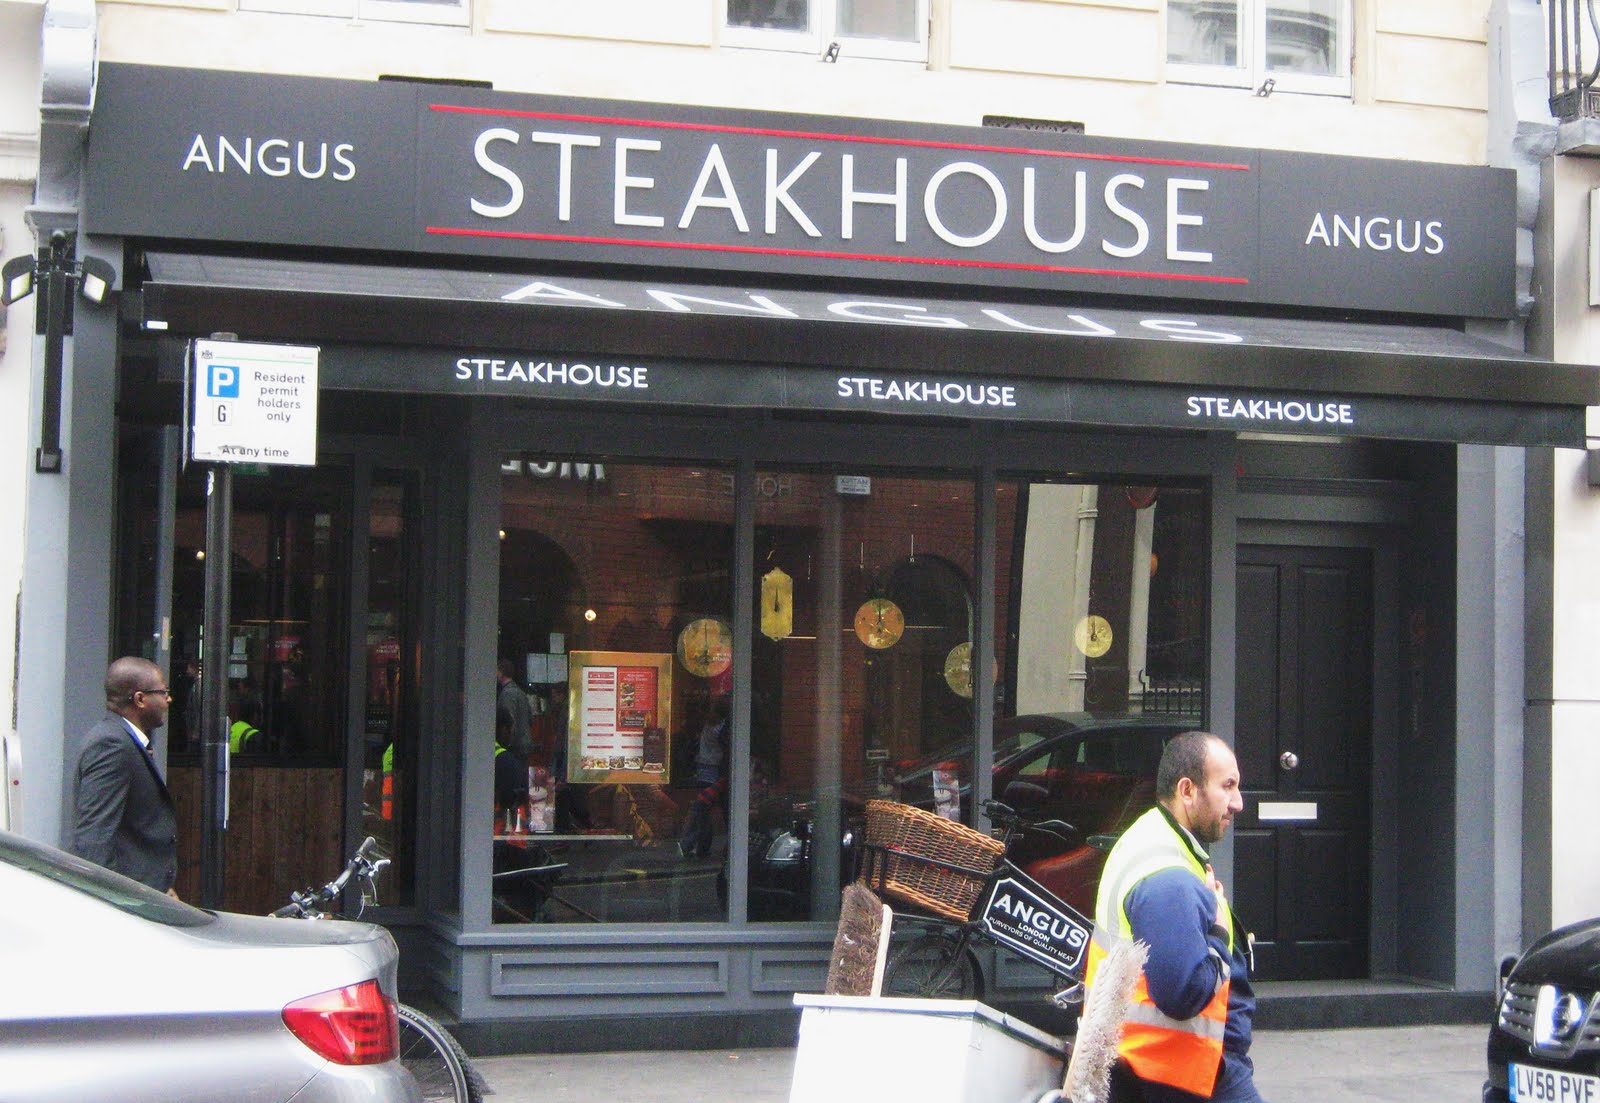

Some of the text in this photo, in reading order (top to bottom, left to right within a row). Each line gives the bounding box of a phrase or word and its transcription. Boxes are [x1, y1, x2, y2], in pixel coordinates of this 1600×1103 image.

[182, 133, 356, 182] ANGUS
[470, 127, 1214, 263] STEAKHOUSE
[1304, 211, 1445, 255] ANGUS
[501, 281, 1243, 344] ANGUS
[212, 367, 235, 396] P
[254, 371, 305, 384] Resident
[455, 358, 649, 389] STEAKHOUSE
[257, 398, 301, 409] holders
[260, 386, 299, 397] permit
[837, 377, 1017, 407] STEAKHOUSE
[217, 404, 226, 422] G
[266, 411, 291, 423] only
[1186, 396, 1354, 424] STEAKHOUSE
[222, 445, 290, 457] At any time
[993, 893, 1086, 948] ANGUS
[1017, 922, 1051, 943] LONDON
[988, 916, 1074, 962] PURVEYORS OF QUALITY MEAT
[1517, 1067, 1556, 1102] LV58
